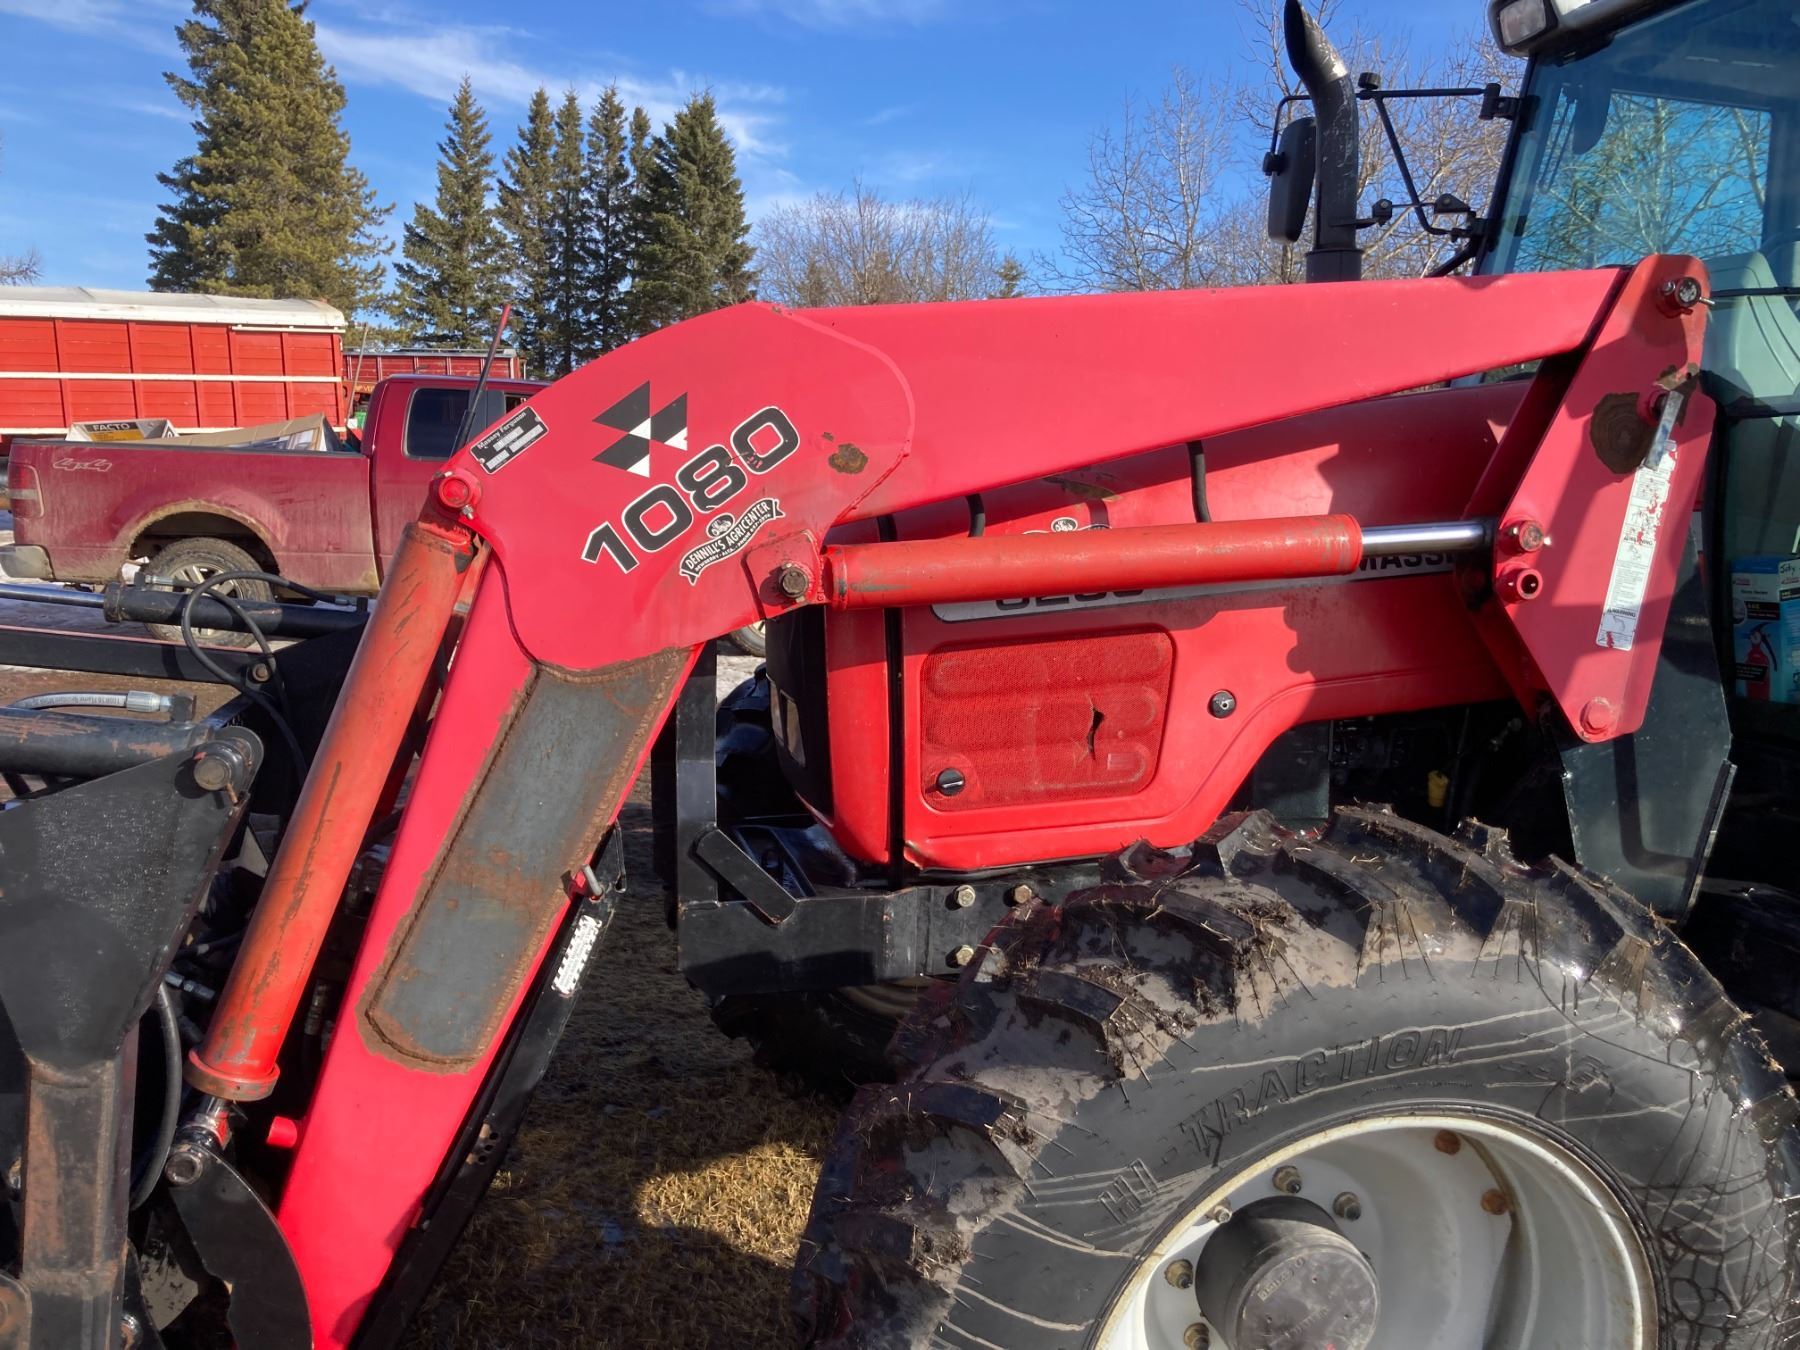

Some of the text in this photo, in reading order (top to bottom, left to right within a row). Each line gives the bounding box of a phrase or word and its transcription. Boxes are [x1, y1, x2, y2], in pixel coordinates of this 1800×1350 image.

[581, 406, 799, 574] 1080
[685, 502, 770, 569] DENNILL'S AGRICENTER
